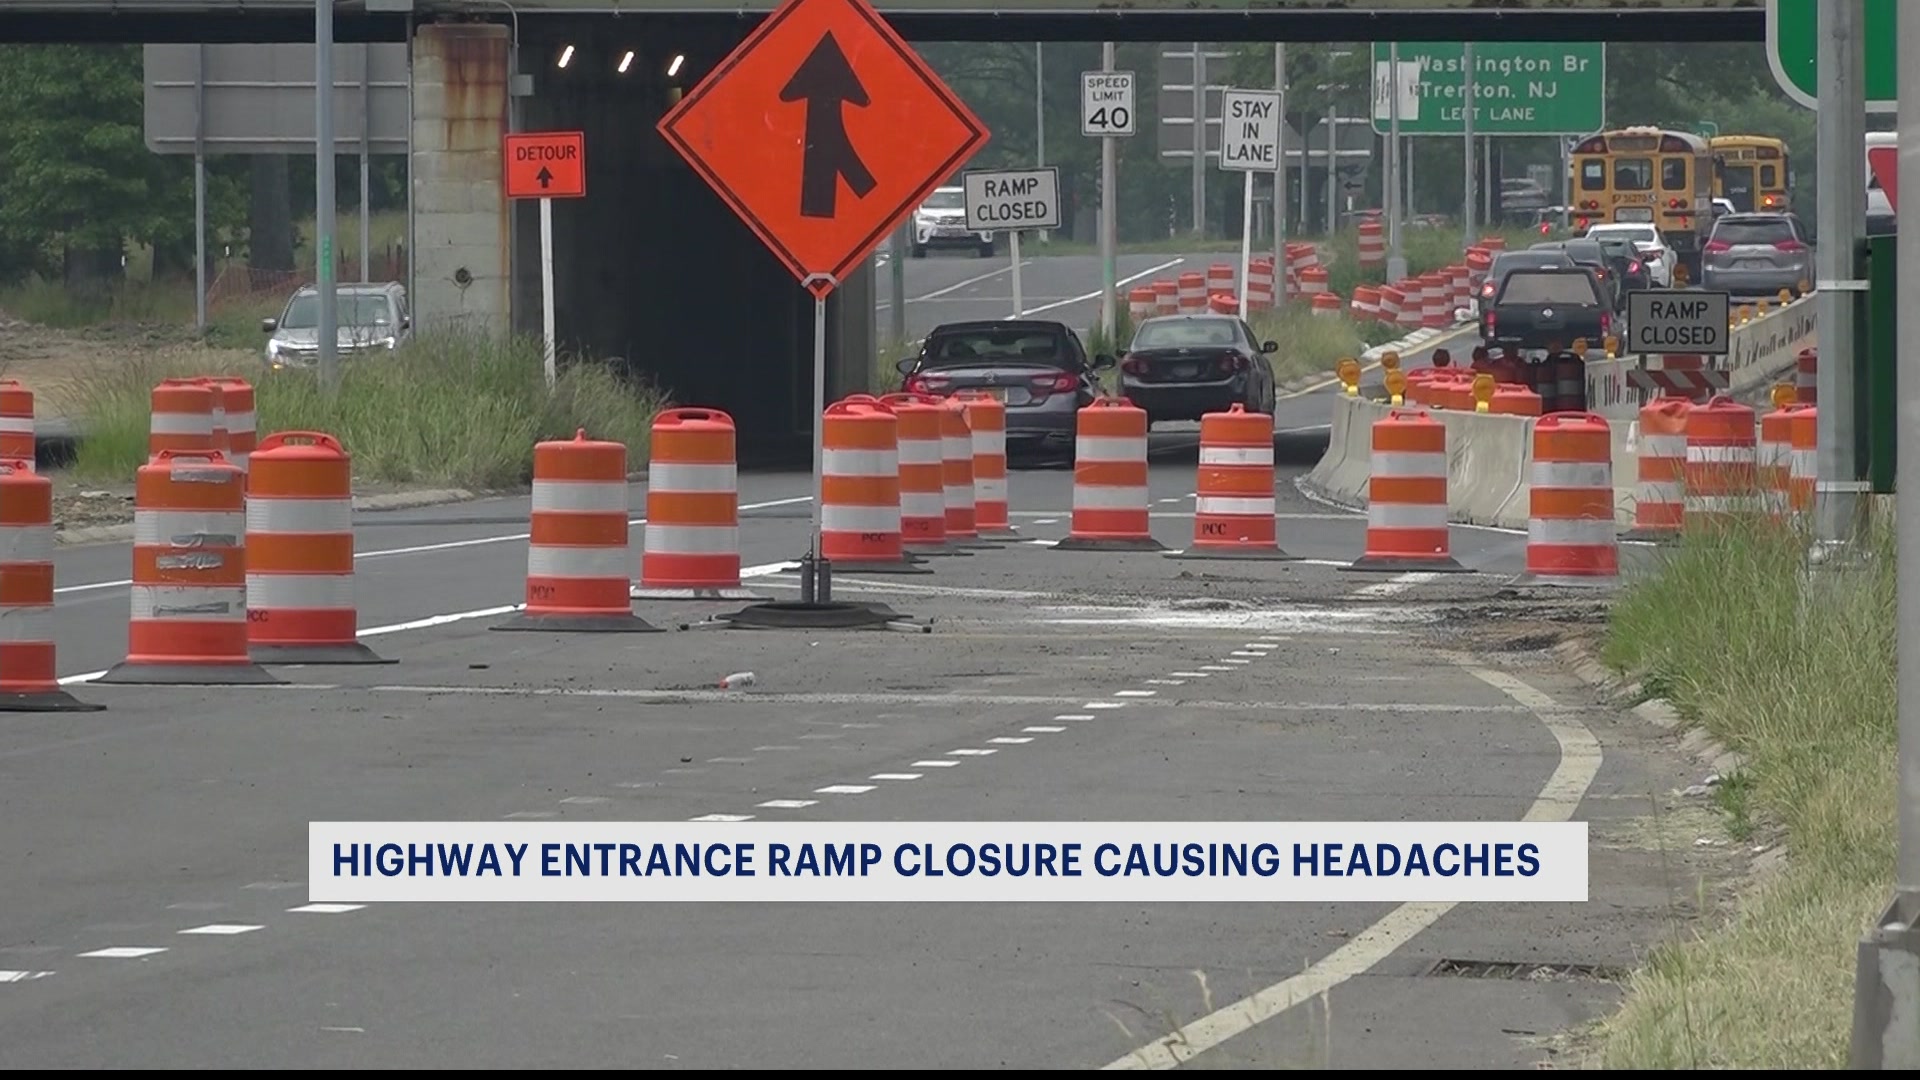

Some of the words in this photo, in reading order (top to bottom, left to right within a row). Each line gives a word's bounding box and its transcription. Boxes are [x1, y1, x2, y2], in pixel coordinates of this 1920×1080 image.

[1563, 55, 1589, 72] Br
[1088, 77, 1129, 88] SPEED
[1528, 81, 1557, 98] NJ
[1092, 91, 1124, 101] LIMIT
[1089, 107, 1129, 128] 40
[1232, 100, 1273, 118] STAY
[1490, 107, 1535, 120] LANE
[1242, 122, 1259, 139] IN
[516, 145, 577, 161] DETOUR
[1227, 144, 1274, 162] LANE
[985, 178, 1038, 198] RAMP
[977, 201, 1047, 221] CLOSED
[1650, 301, 1709, 320] RAMP
[1640, 326, 1717, 345] CLOSED
[1202, 522, 1227, 536] PCC
